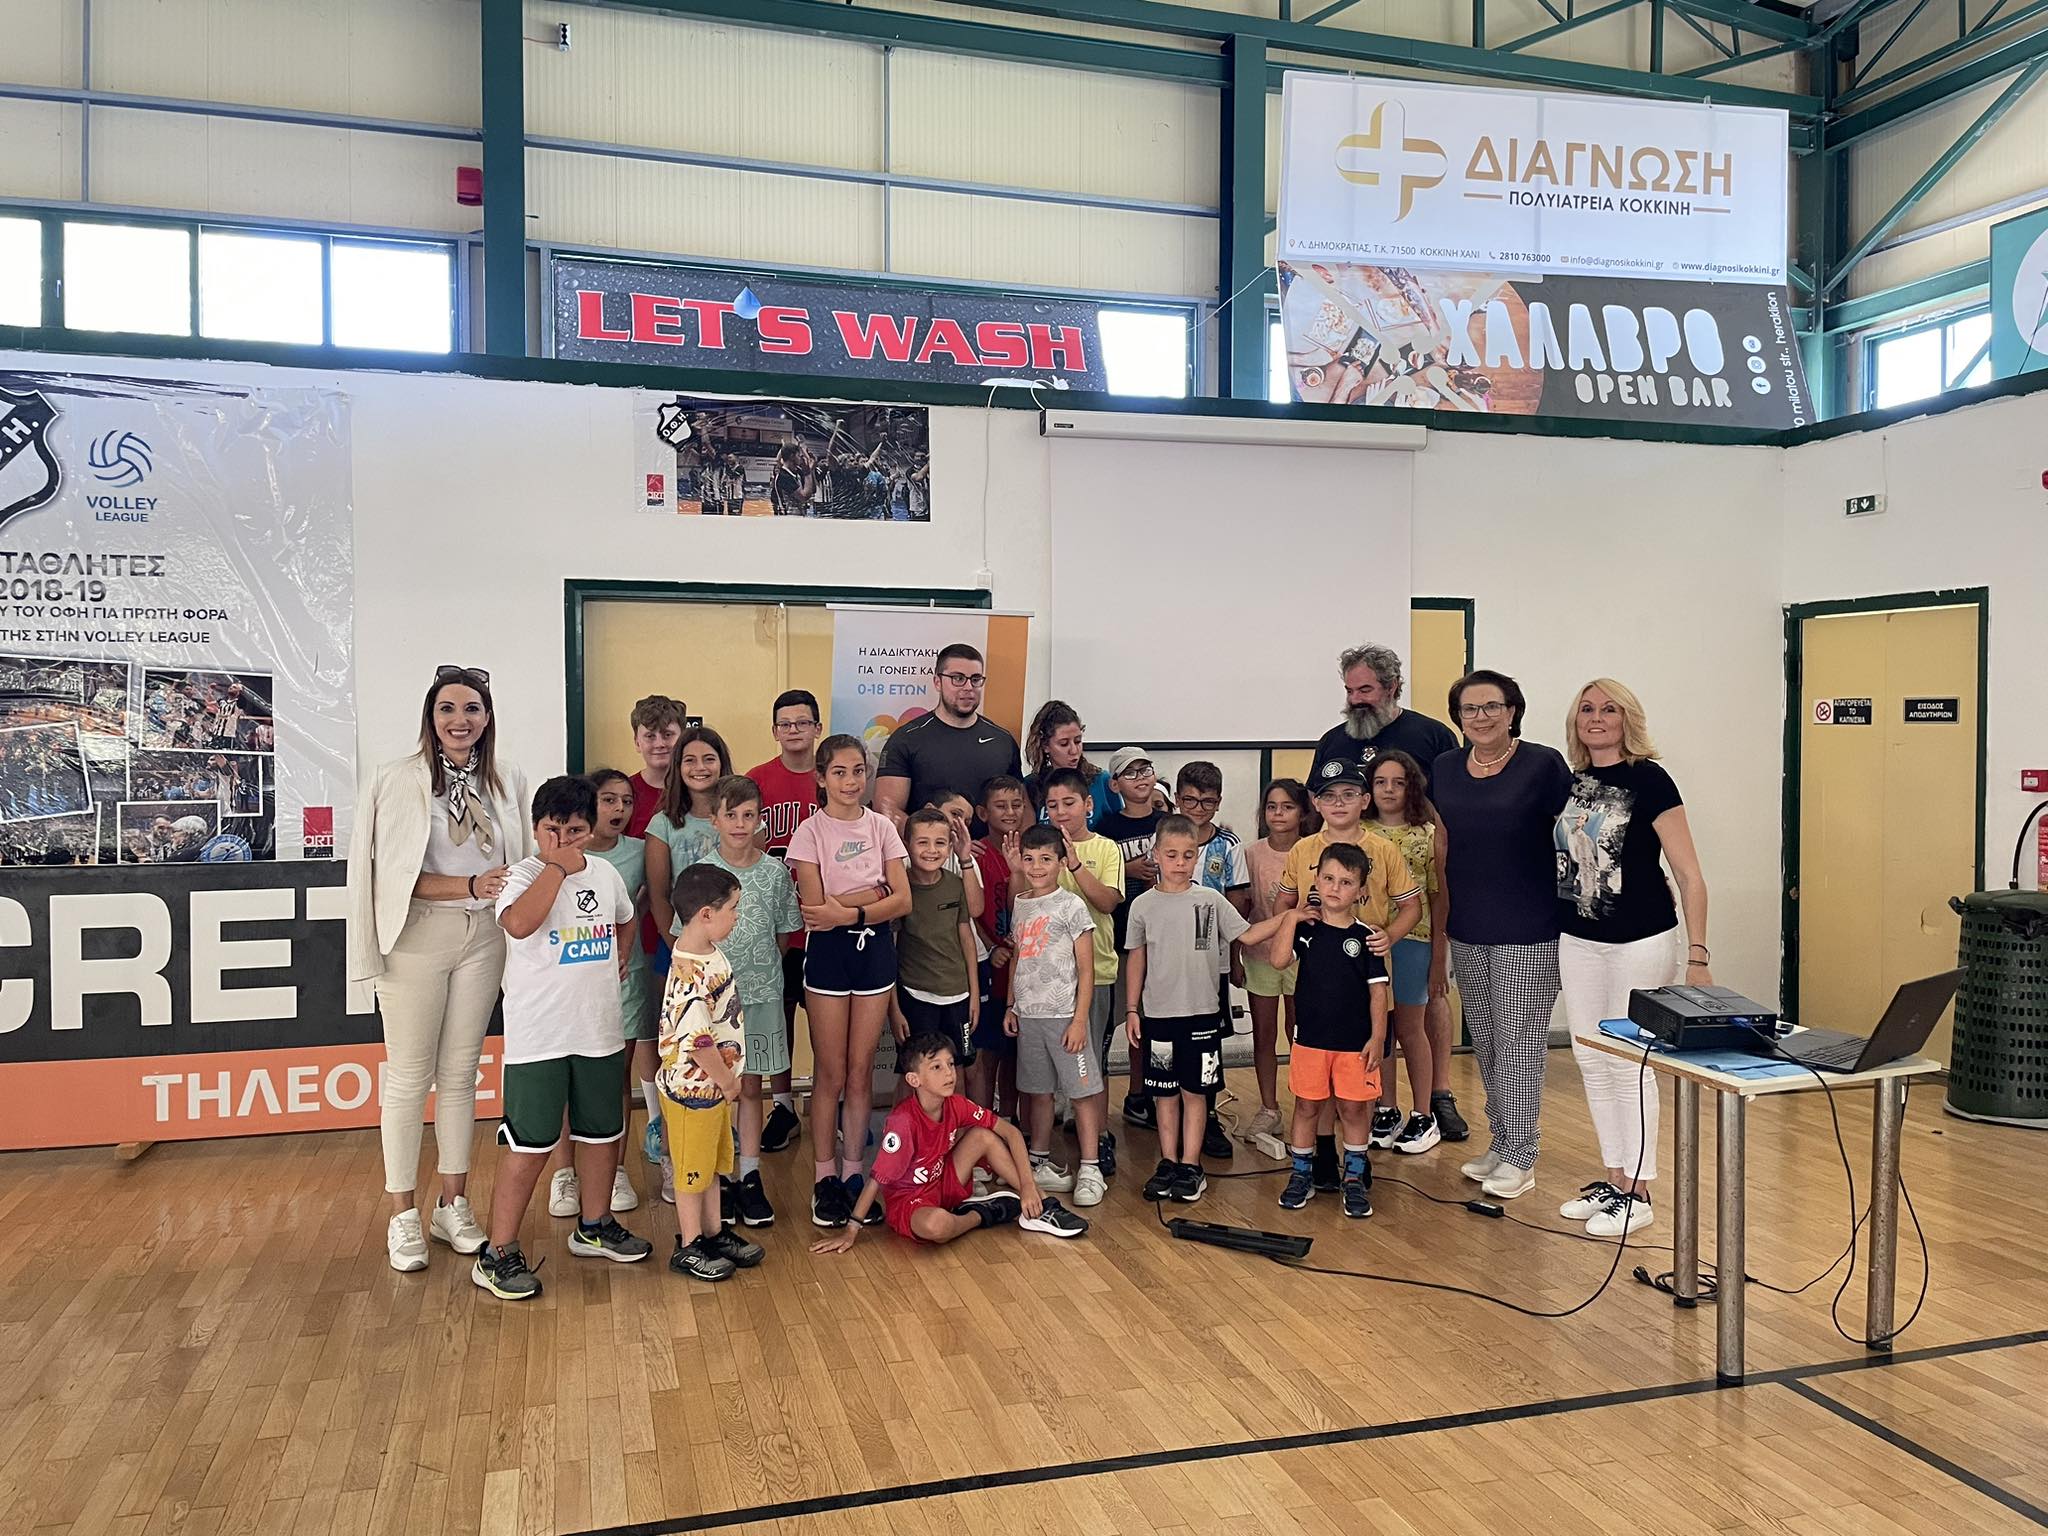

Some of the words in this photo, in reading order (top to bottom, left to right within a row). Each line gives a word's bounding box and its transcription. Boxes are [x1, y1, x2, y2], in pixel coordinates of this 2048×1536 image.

[1465, 136, 1732, 196] ΔΙΑΓΝΩΣΗ
[1509, 191, 1614, 211] ΠΟΛΥΙΑΤΡΕΙΑ
[1620, 198, 1691, 216] ΚΟΚΚΙΝΗ
[1391, 245, 1416, 255] 71500
[1420, 247, 1459, 258] ΚΟΚΚΙΝΗ
[1460, 249, 1480, 259] ΧΑΝΙ
[1499, 251, 1520, 261] 2810
[1522, 252, 1551, 263] 763000
[1570, 255, 1664, 269] info@diagnosikokkini.gr
[1680, 261, 1780, 276] www.diagnosikokkini.gr
[1767, 291, 1787, 344] heraklion
[831, 310, 1088, 372] WASH
[1439, 298, 1725, 376] ΧΑΛΑΒΡΟ
[1574, 373, 1659, 405] OPEN
[1668, 375, 1733, 408] BAR
[86, 495, 158, 510] VOLLEY
[95, 511, 149, 523] LEAGUE
[13, 605, 45, 618] ΤΟΥ
[50, 606, 88, 619] ΟΦΗ
[93, 607, 119, 620] ΓΙΑ
[123, 607, 178, 620] ΠΡΩΤΗ
[183, 608, 229, 621] ΦΟΡΑ
[36, 629, 79, 643] ΣΤΗΝ
[84, 630, 145, 643] VOLLEY
[150, 631, 210, 644] LEAGUE
[858, 647, 867, 656] Η
[869, 648, 939, 658] ΔΙΑΔΙΚΤΥΑΚΗ
[858, 665, 874, 675] ΓΙΑ
[880, 665, 918, 676] ΓΟΝΕΙΣ
[857, 683, 885, 696] 0-18
[889, 684, 927, 697] ΕΤΩΝ
[1917, 702, 1944, 710] ΕΙΣΟΔΟΣ
[1908, 711, 1953, 719] ΑΠΟΔΥΤΗΡΙΩΝ
[840, 840, 866, 854] NIKE
[567, 941, 610, 959] CAMP
